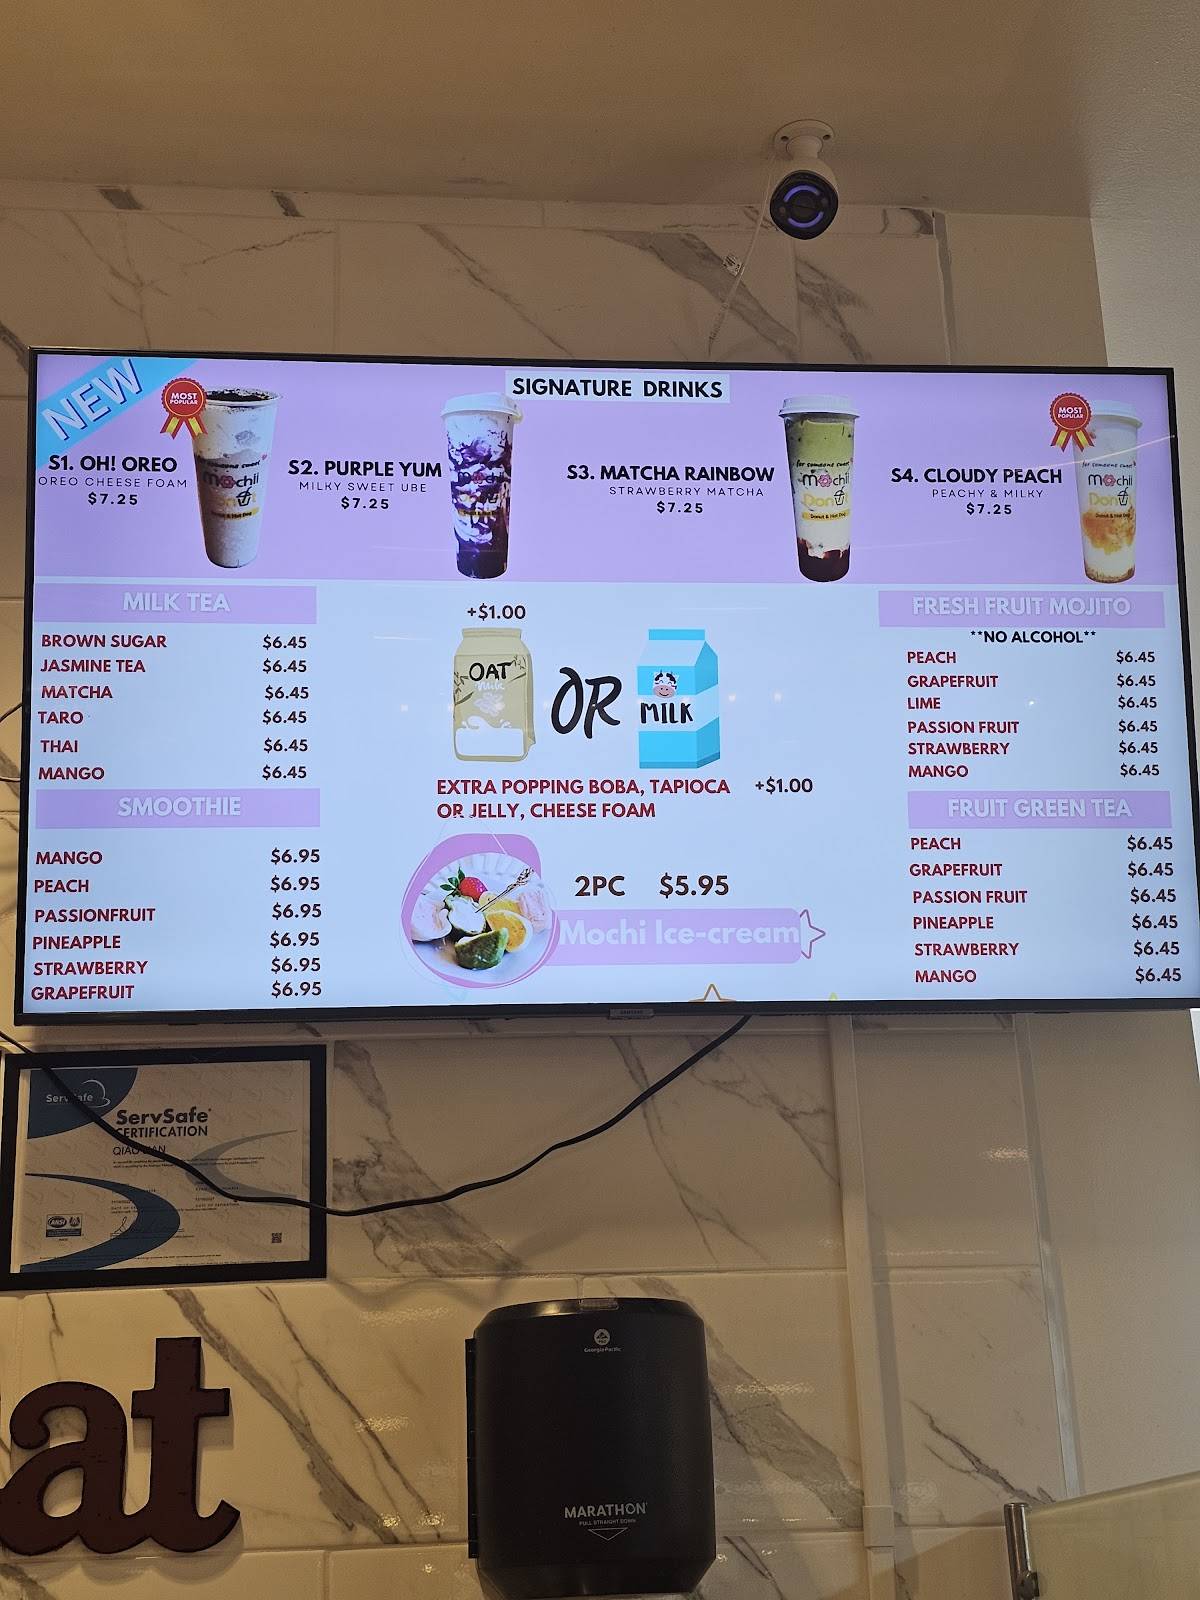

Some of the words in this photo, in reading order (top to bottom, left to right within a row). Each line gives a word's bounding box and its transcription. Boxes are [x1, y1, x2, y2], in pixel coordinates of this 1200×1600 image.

[512, 378, 632, 396] SIGNATURE
[644, 380, 723, 398] DRINKS
[42, 358, 142, 440] NEW
[172, 392, 198, 400] MOST
[48, 455, 74, 471] S1.
[80, 456, 116, 472] OH!
[122, 456, 177, 472] OREO
[288, 460, 318, 476] S2.
[325, 461, 394, 476] PURPLE
[399, 462, 442, 478] YUM
[567, 465, 595, 480] S3.
[600, 466, 680, 481] MATCHA
[685, 467, 774, 482] RAINBOW
[891, 468, 918, 482] S4.
[924, 468, 998, 483] CLOUDY
[1004, 469, 1062, 484] PEACH
[38, 476, 78, 486] OREO
[85, 477, 140, 488] CHEESE
[148, 478, 187, 488] FOAM
[300, 482, 341, 491] MILKY
[348, 482, 394, 492] SWEET
[402, 484, 426, 492] UBE
[88, 492, 138, 505] $7.25
[609, 486, 700, 496] STRAWBERRY
[708, 488, 764, 496] MATCHA
[932, 489, 984, 498] PEACHY
[990, 489, 998, 498] &
[1004, 489, 1044, 498] MILKY
[341, 497, 389, 510] $7.25
[656, 501, 703, 514] $7.25
[966, 502, 1012, 515] $7.25
[123, 592, 180, 612] MILK
[187, 592, 230, 612] TEA
[912, 597, 978, 616] FRESH
[984, 597, 1044, 616] FRUIT
[1050, 598, 1131, 616] MOJITO
[467, 603, 526, 620] +$1.00
[42, 635, 106, 648] BROWN
[111, 634, 167, 648] SUGAR
[262, 634, 307, 650] $6.45
[907, 652, 956, 664] PEACH
[1116, 650, 1156, 665] $6.45
[40, 660, 110, 673] JASMINE
[116, 660, 146, 672] TEA
[262, 658, 307, 674] $6.45
[469, 662, 511, 681] OAT
[908, 676, 998, 688] GRAPEFRUIT
[1116, 674, 1156, 688] $6.45
[42, 686, 112, 699] MATCHA
[264, 685, 309, 700] $6.45
[551, 666, 622, 739] OR
[908, 698, 940, 710] LIME
[1118, 696, 1157, 710] $6.45
[38, 712, 84, 724] TARO
[262, 710, 307, 725] $6.45
[640, 702, 694, 724] MILK
[908, 722, 974, 734] PASSION
[979, 722, 1019, 734] FRUIT
[1118, 720, 1158, 734] $6.45
[40, 740, 78, 753] THAI
[264, 738, 308, 754] $6.45
[908, 742, 1010, 755] STRAWBERRY
[1118, 740, 1158, 755] $6.45
[38, 767, 104, 780] MANGO
[262, 764, 306, 780] $6.45
[908, 765, 968, 778] MANGO
[1120, 763, 1160, 778] $6.45
[437, 780, 496, 794] EXTRA
[502, 780, 584, 794] POPPING
[589, 779, 644, 797] BOBA,
[650, 779, 730, 794] TAPIOCA
[755, 776, 813, 794] +$1.00
[117, 796, 241, 817] SMOOTHIE
[437, 803, 462, 818] OR
[472, 803, 524, 820] JELLY,
[530, 802, 596, 818] CHEESE
[602, 802, 656, 818] FOAM
[948, 799, 1008, 818] FRUIT
[1013, 798, 1086, 818] GREEN
[1092, 798, 1133, 818] TEA
[911, 838, 960, 850] PEACH
[1127, 836, 1172, 852] $6.45
[36, 852, 102, 865] MANGO
[270, 848, 320, 865] $6.95
[910, 864, 1002, 876] GRAPEFRUIT
[1128, 862, 1174, 878] $6.45
[34, 880, 88, 892] PEACH
[270, 875, 320, 892] $6.95
[574, 876, 625, 896] 2PC
[660, 872, 728, 899] $5.95
[913, 890, 981, 904] PASSION
[986, 890, 1027, 904] FRUIT
[1130, 888, 1176, 904] $6.45
[35, 908, 156, 922] PASSIONFRUIT
[272, 902, 322, 920] $6.95
[913, 916, 994, 930] PINEAPPLE
[1132, 914, 1178, 930] $6.45
[270, 930, 320, 948] $6.95
[560, 919, 646, 945] Mochi
[656, 919, 800, 944] Ice-cream
[32, 936, 120, 950] PINEAPPLE
[914, 943, 1019, 956] STRAWBERRY
[1134, 940, 1180, 957] $6.45
[33, 961, 148, 976] STRAWBERRY
[271, 956, 320, 974] $6.95
[915, 970, 976, 982] MANGO
[1135, 966, 1182, 983] $6.45
[31, 985, 134, 1000] GRAPEFRUIT
[272, 980, 322, 998] $6.95
[46, 1094, 94, 1103] Servafe
[116, 1106, 208, 1125] ServSafe
[116, 1126, 208, 1138] CERTIFICATION
[564, 1502, 646, 1518] MARATHON
